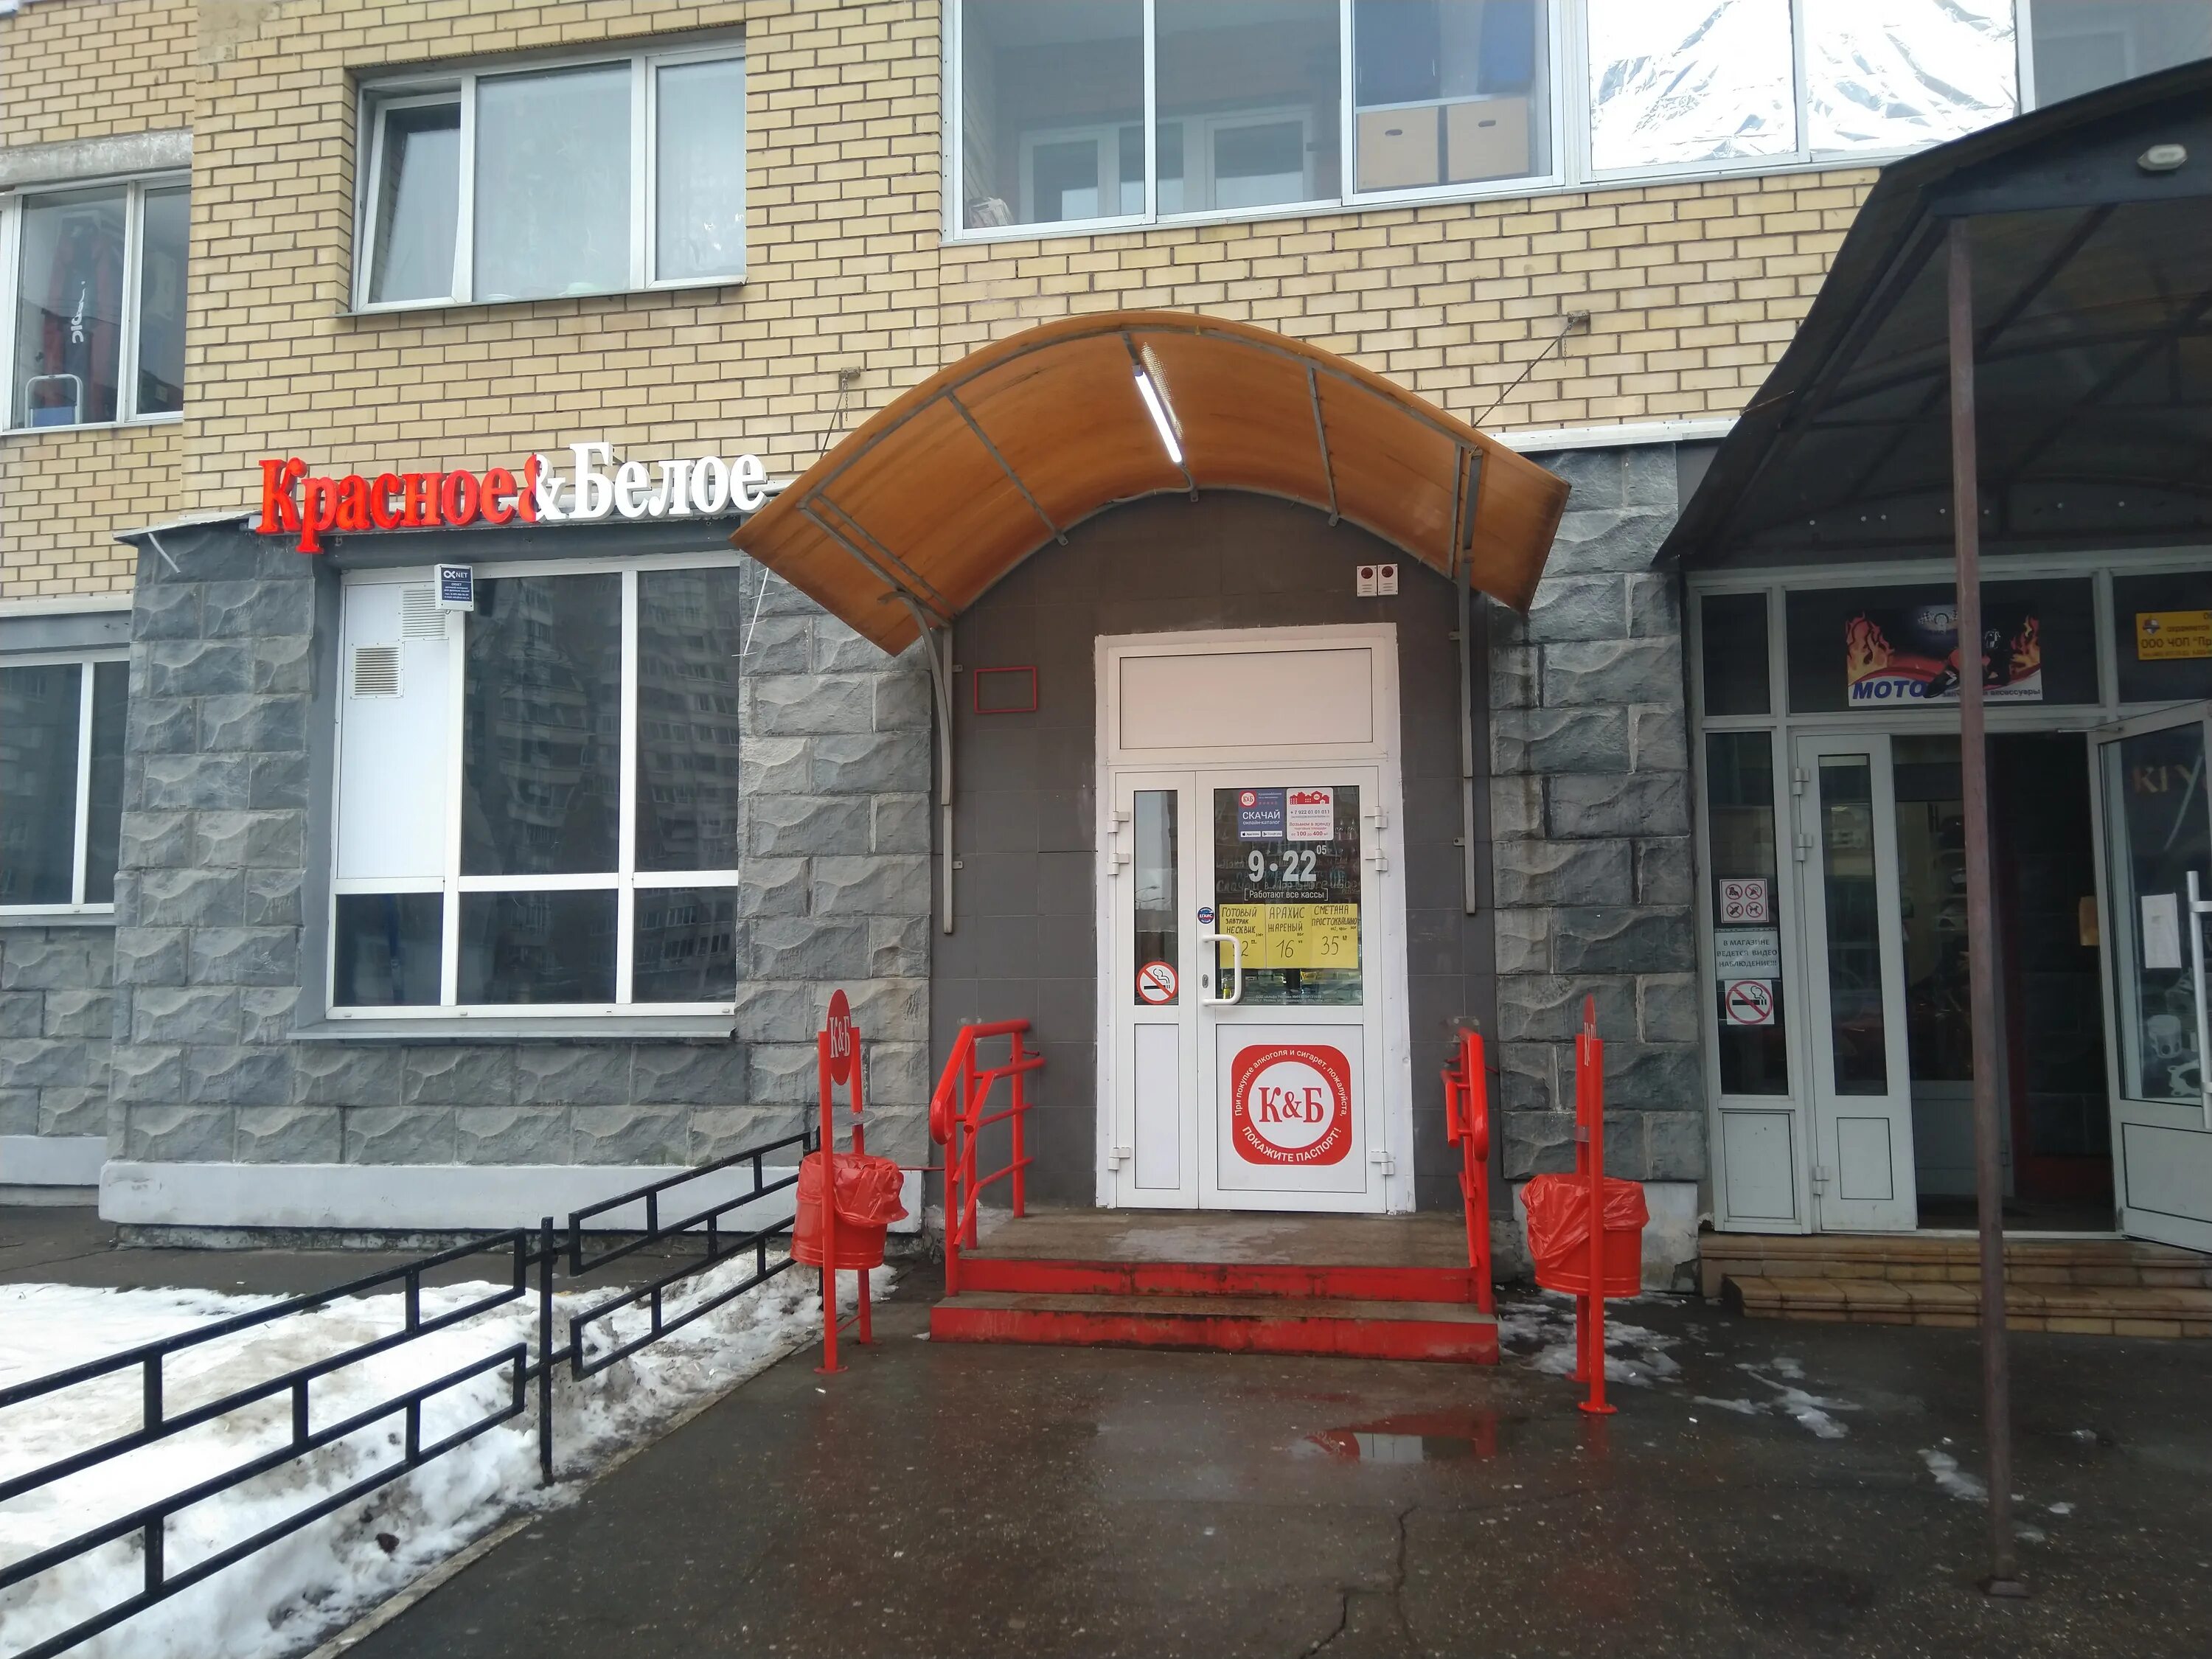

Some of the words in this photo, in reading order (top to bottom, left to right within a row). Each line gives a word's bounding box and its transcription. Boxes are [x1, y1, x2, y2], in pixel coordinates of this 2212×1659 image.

[2140, 638, 2165, 649] ООО
[2168, 636, 2190, 647] ЧОП
[1242, 810, 1281, 819] СКАЧАЙ
[1316, 844, 1327, 855] 05
[1249, 890, 1284, 899] Работают
[1222, 907, 1257, 917] ГОТОВЫЙ
[1269, 906, 1305, 919] АРАХИС
[1314, 905, 1349, 915] СМЕТАНА
[1267, 921, 1303, 932] ЖАРЕНЫЙ
[1312, 917, 1357, 926] ПРОСТОКВАШИНО
[1226, 925, 1256, 934] НЕСКВИК
[1276, 939, 1295, 959] 16
[1321, 936, 1340, 956] 35
[829, 1015, 851, 1058] К&Б
[1253, 1049, 1288, 1068] алкоголя
[1296, 1050, 1328, 1070] сигарет,
[1236, 1067, 1254, 1098] покупке
[1326, 1067, 1349, 1117] пожалуйста,
[1234, 1099, 1243, 1116] При
[1258, 1086, 1324, 1123] К&Б
[1242, 1126, 1294, 1162] ПОКАЖИТЕ
[1295, 1127, 1342, 1162] ПАСПОРТ!
